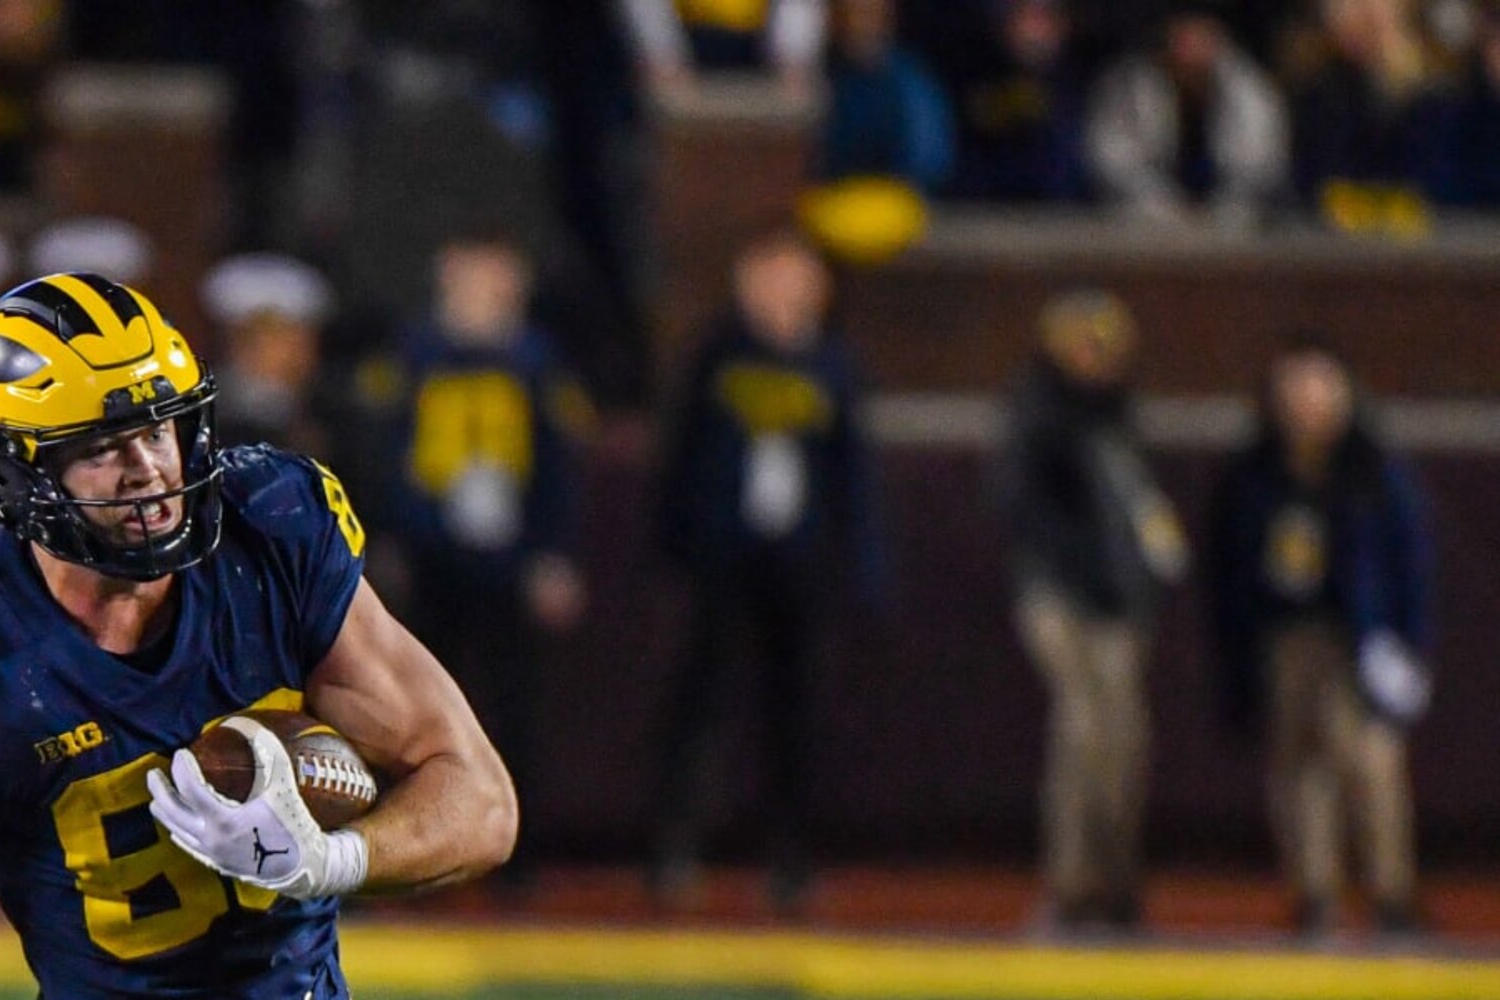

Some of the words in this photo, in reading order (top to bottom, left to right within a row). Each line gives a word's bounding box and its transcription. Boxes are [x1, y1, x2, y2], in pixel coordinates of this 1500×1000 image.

[128, 381, 156, 403] M
[308, 457, 365, 557] 8
[52, 688, 305, 960] 8
